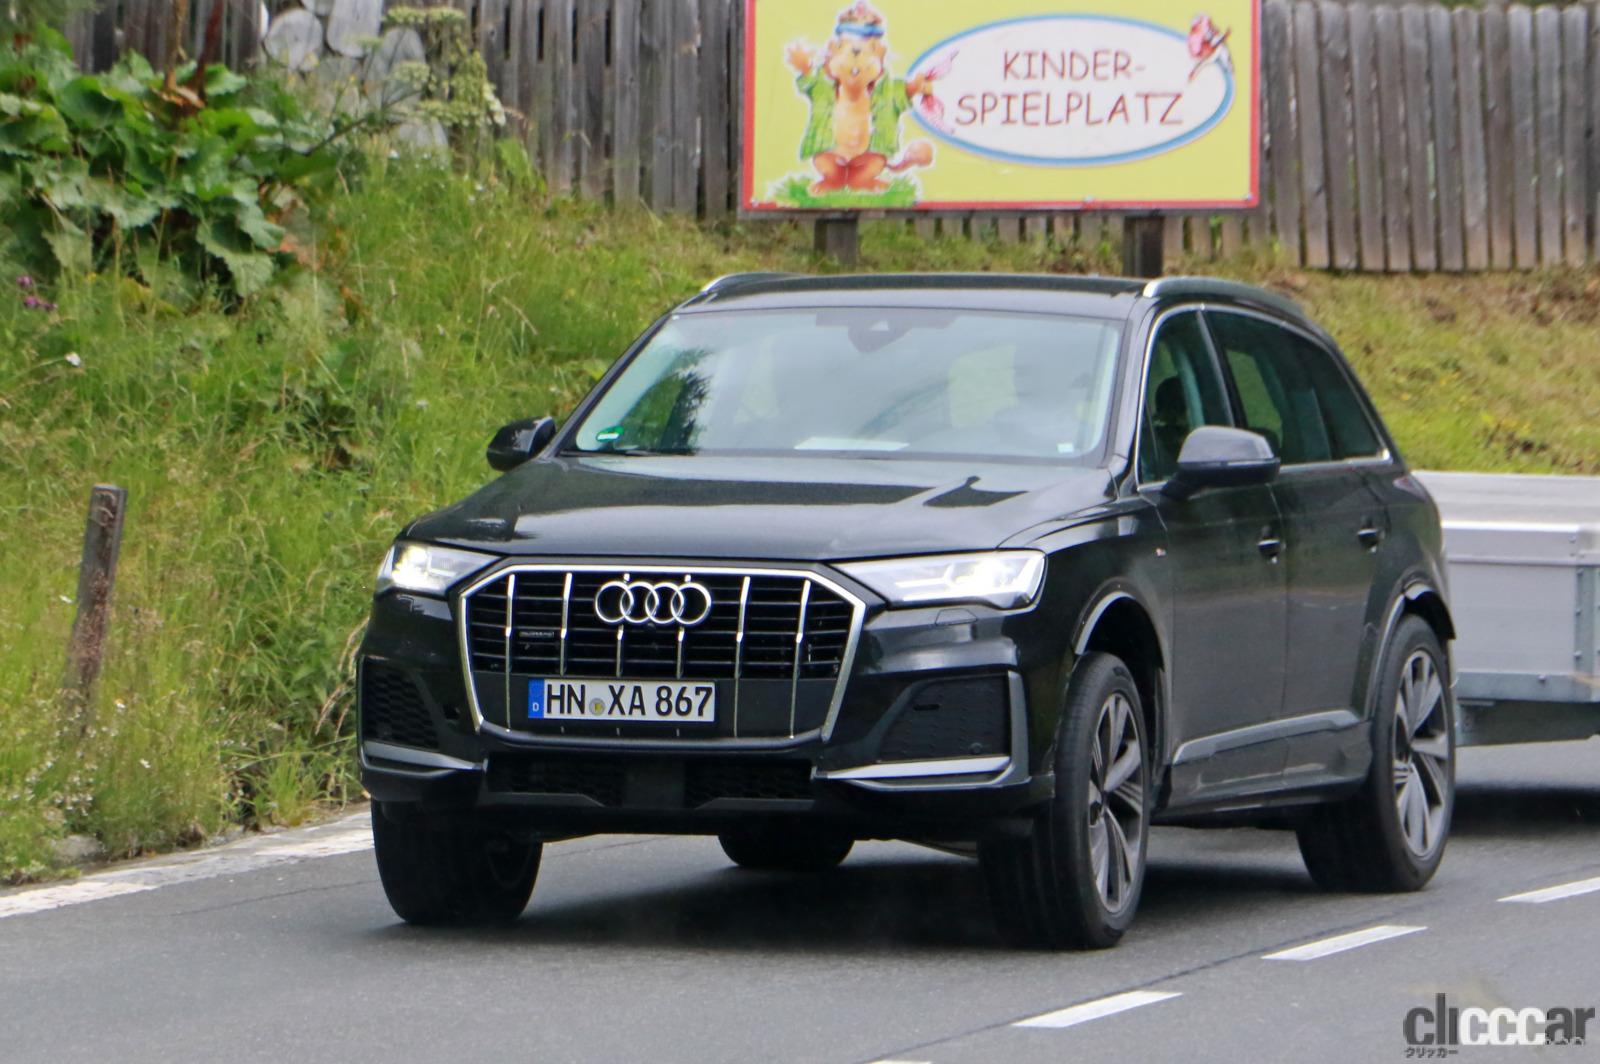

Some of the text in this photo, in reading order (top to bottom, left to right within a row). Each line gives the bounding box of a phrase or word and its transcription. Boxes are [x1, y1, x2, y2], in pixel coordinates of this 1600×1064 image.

[1003, 49, 1146, 81] KINDER-
[955, 91, 1184, 126] SPIELPLATZ
[546, 684, 713, 717] HN XA 867
